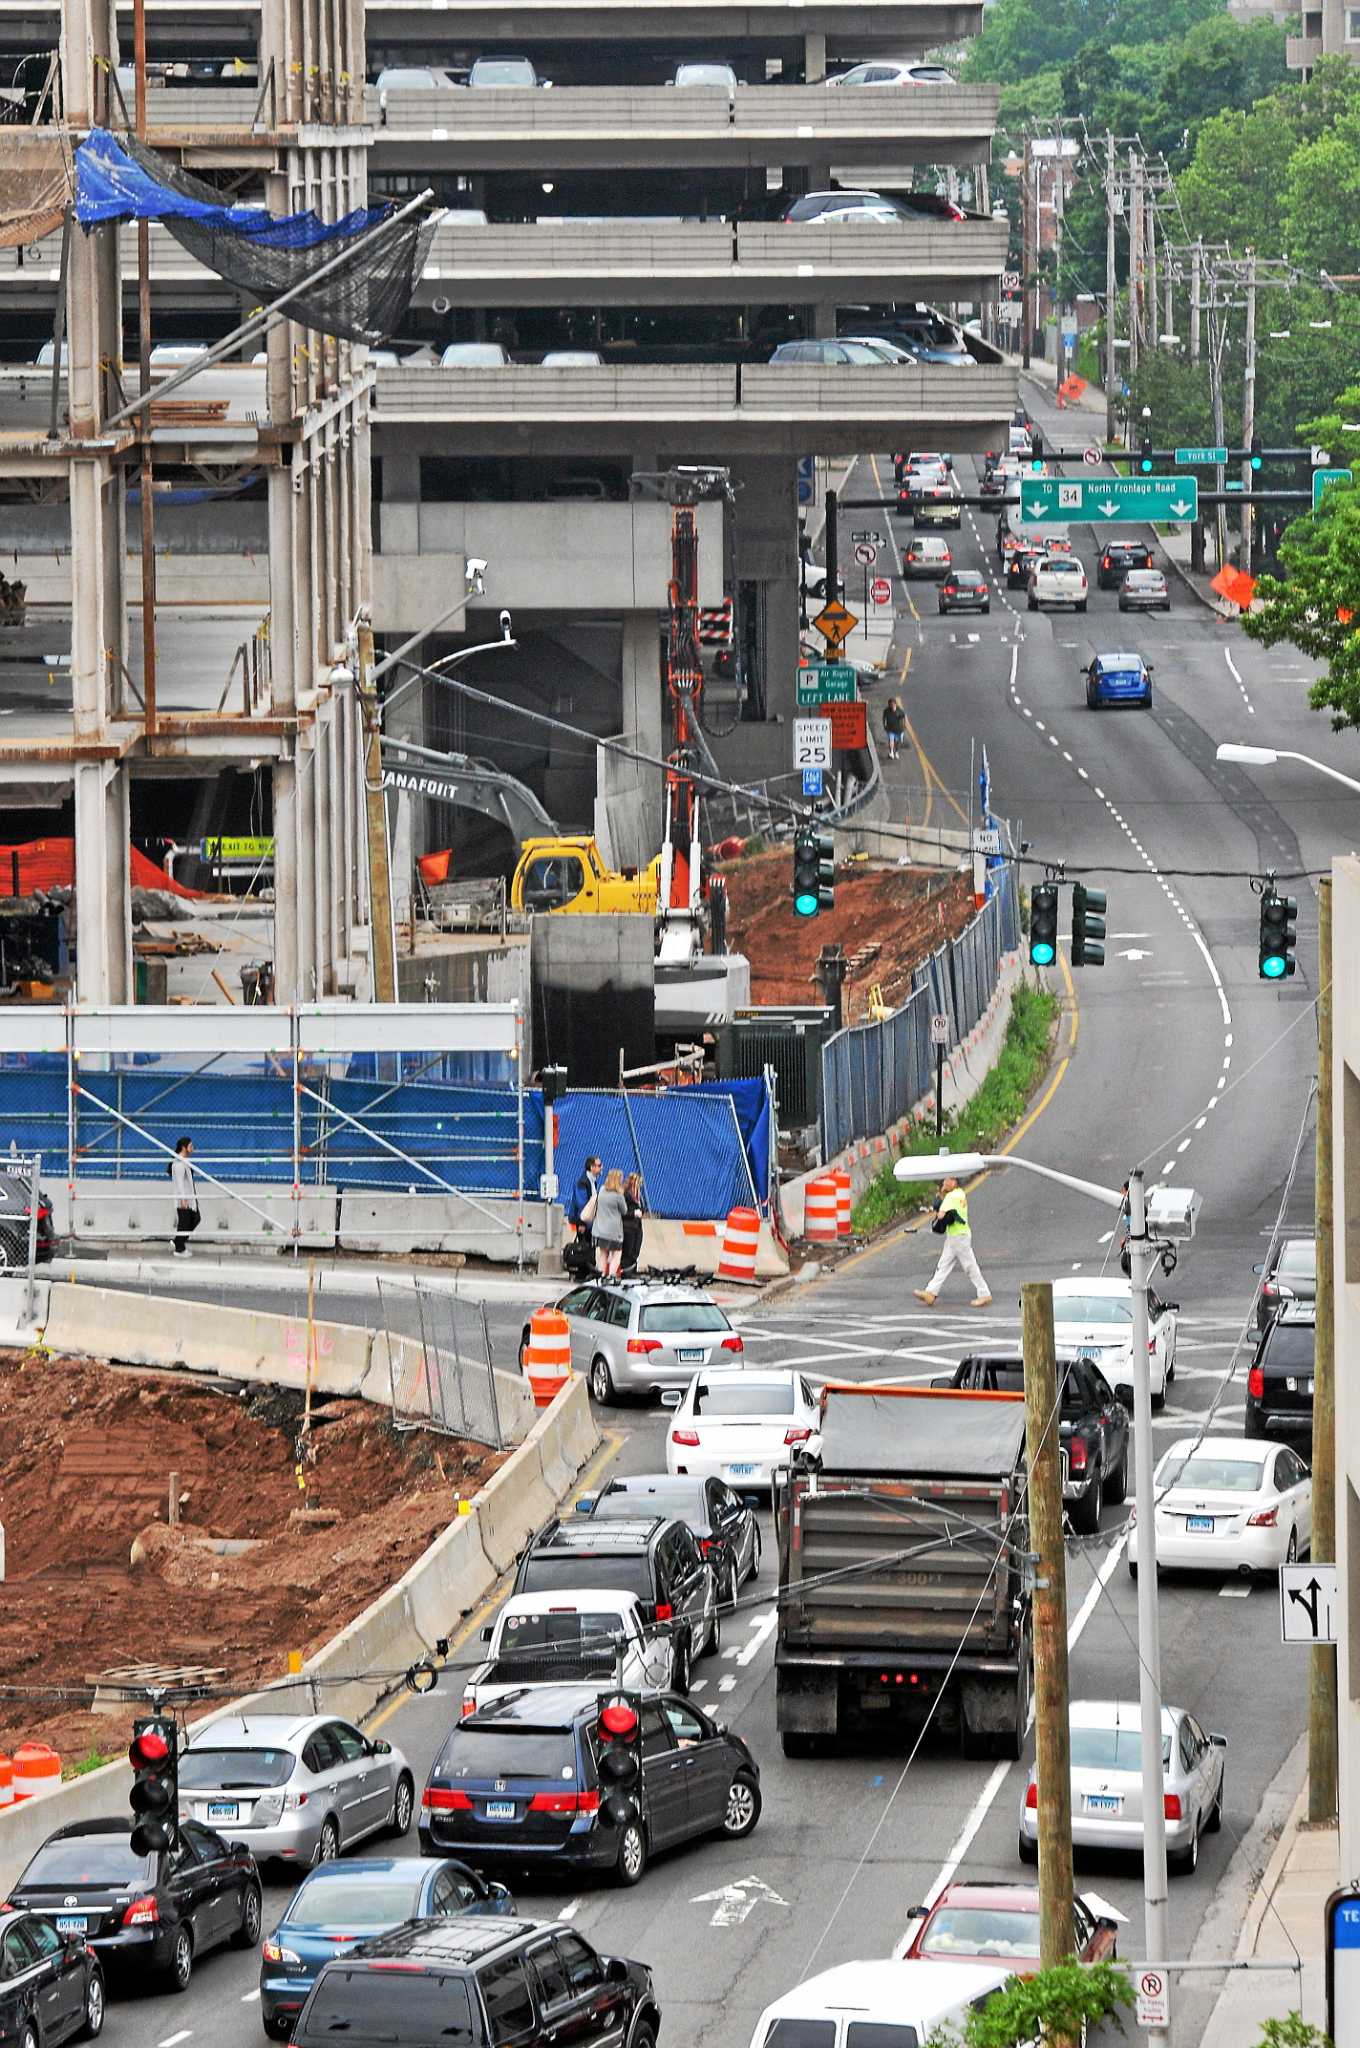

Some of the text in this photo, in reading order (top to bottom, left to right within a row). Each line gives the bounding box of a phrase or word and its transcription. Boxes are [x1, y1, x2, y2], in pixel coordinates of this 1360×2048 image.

[1188, 452, 1205, 461] York
[1043, 482, 1176, 503] TO 34 North Frontage Road
[806, 674, 814, 686] P
[820, 670, 830, 678] Air
[825, 680, 848, 691] Garage
[802, 692, 850, 704] LEFT LANE
[797, 723, 828, 732] SPEED
[800, 735, 823, 744] LIMIT
[799, 747, 826, 763] 25
[980, 834, 993, 842] NO
